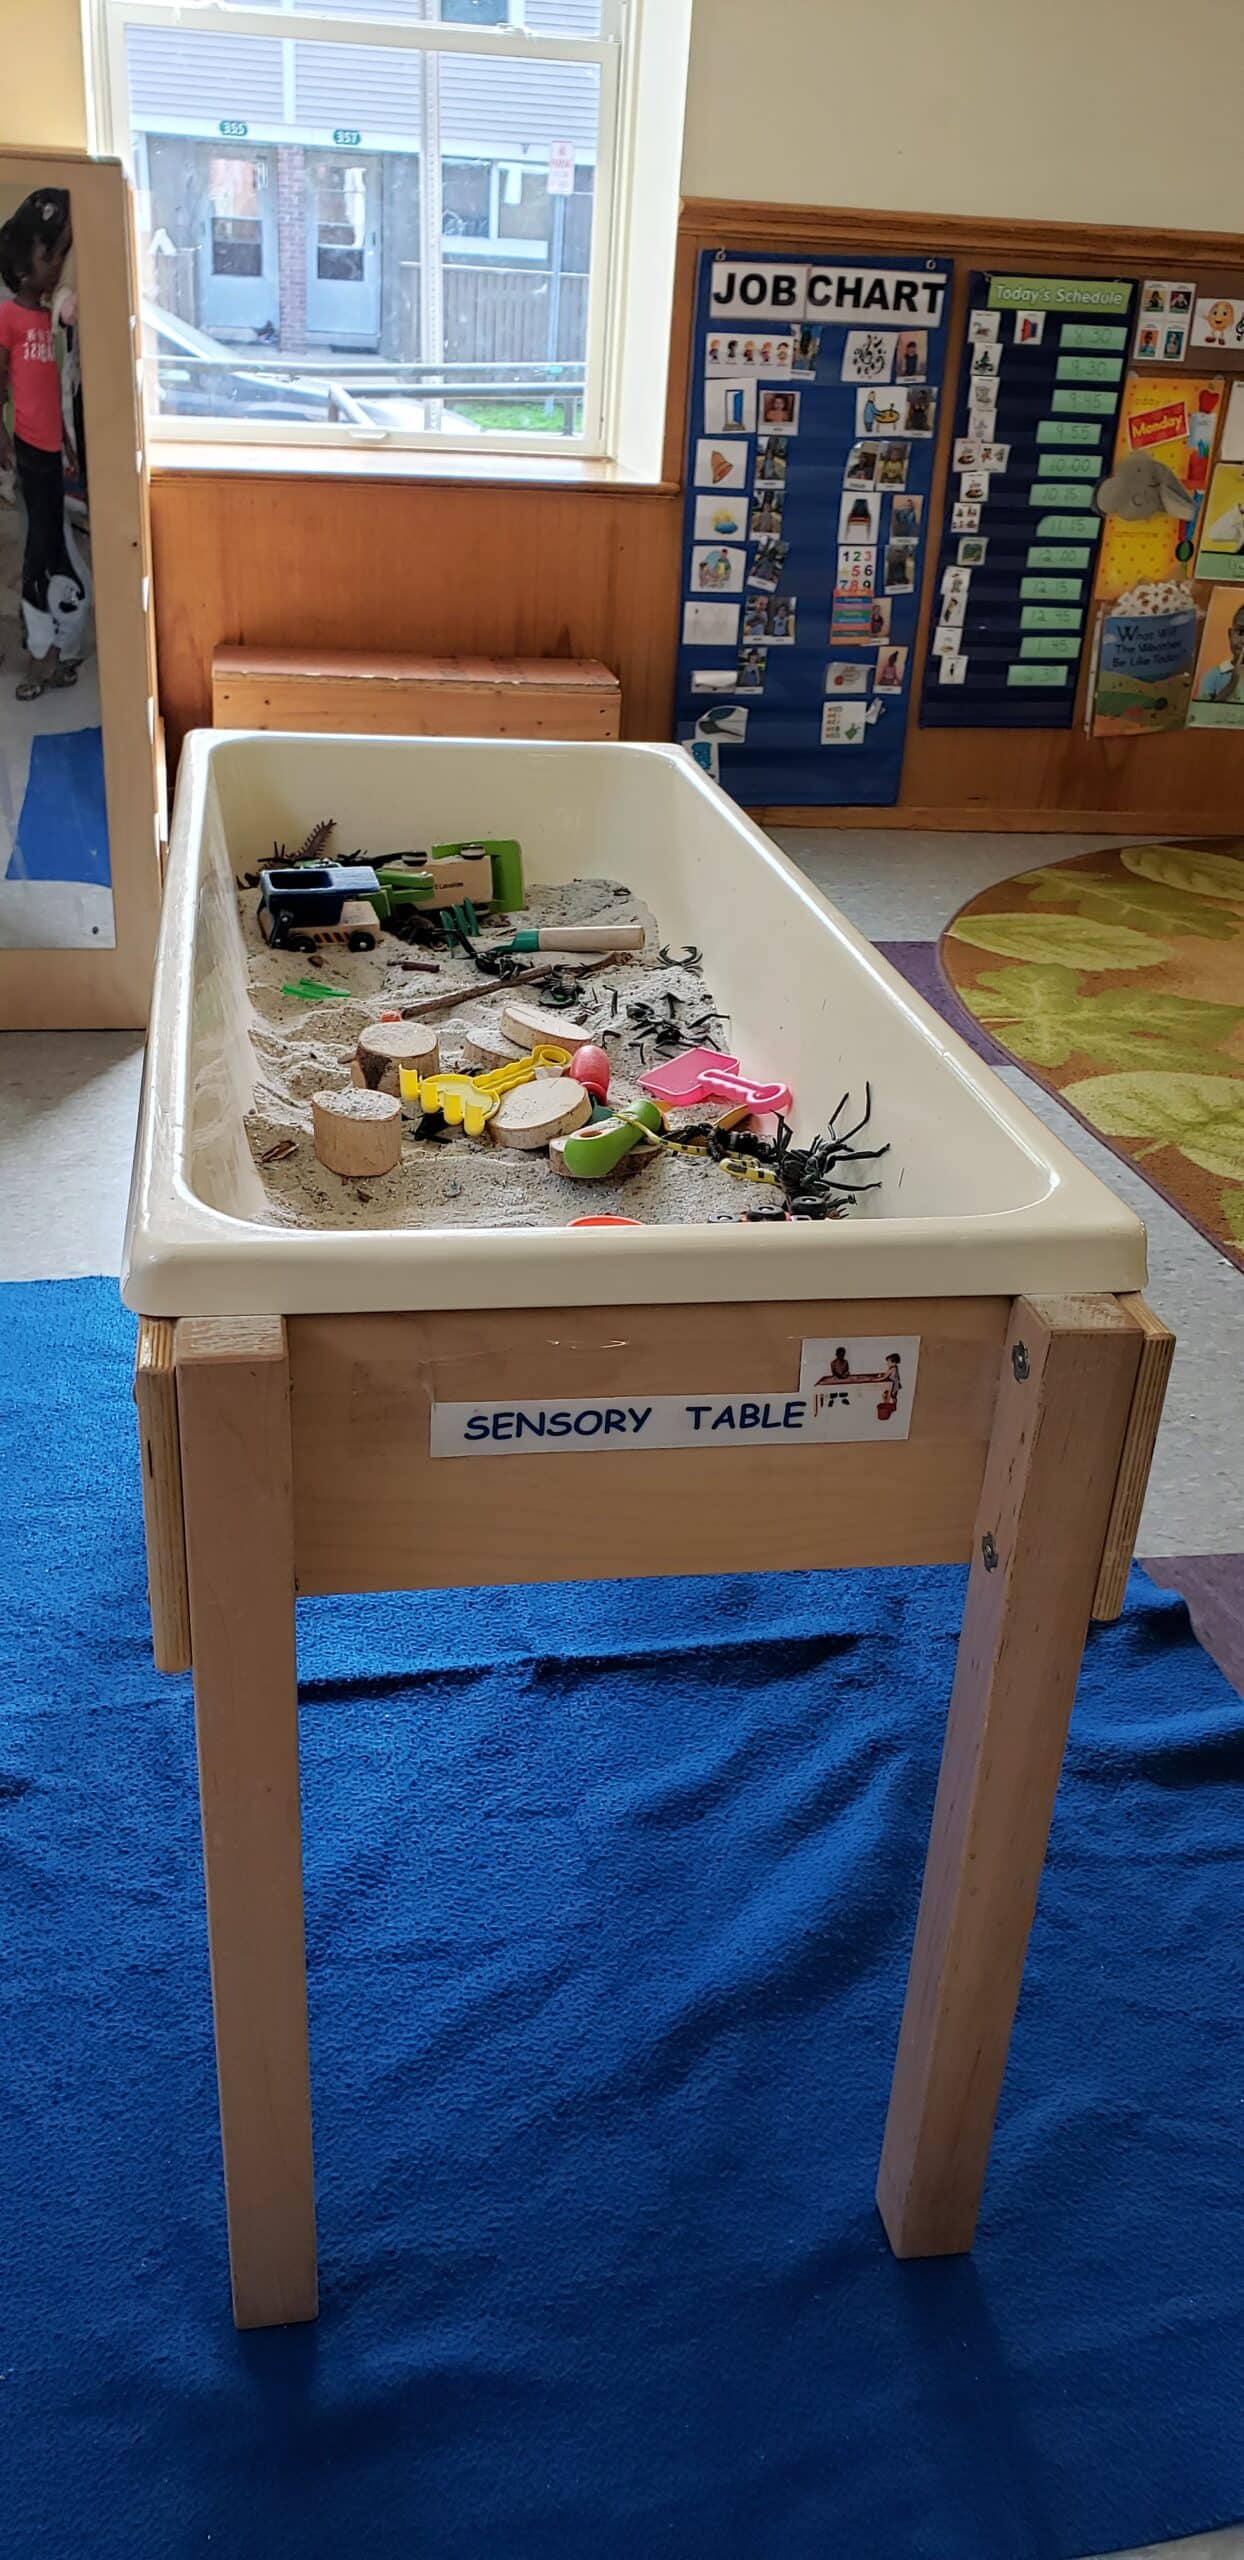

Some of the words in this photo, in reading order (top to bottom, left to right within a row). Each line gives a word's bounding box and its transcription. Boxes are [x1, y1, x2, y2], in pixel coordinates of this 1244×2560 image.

[713, 272, 797, 307] JOB
[807, 274, 947, 314] CHART
[997, 284, 1050, 305] Today's
[1056, 288, 1123, 305] Schedule
[1131, 413, 1184, 438] Monday
[842, 551, 850, 562] 1
[853, 551, 861, 562] 2
[864, 565, 873, 577] 6
[463, 1406, 653, 1441] SENSORY
[685, 1400, 808, 1431] TABLE
